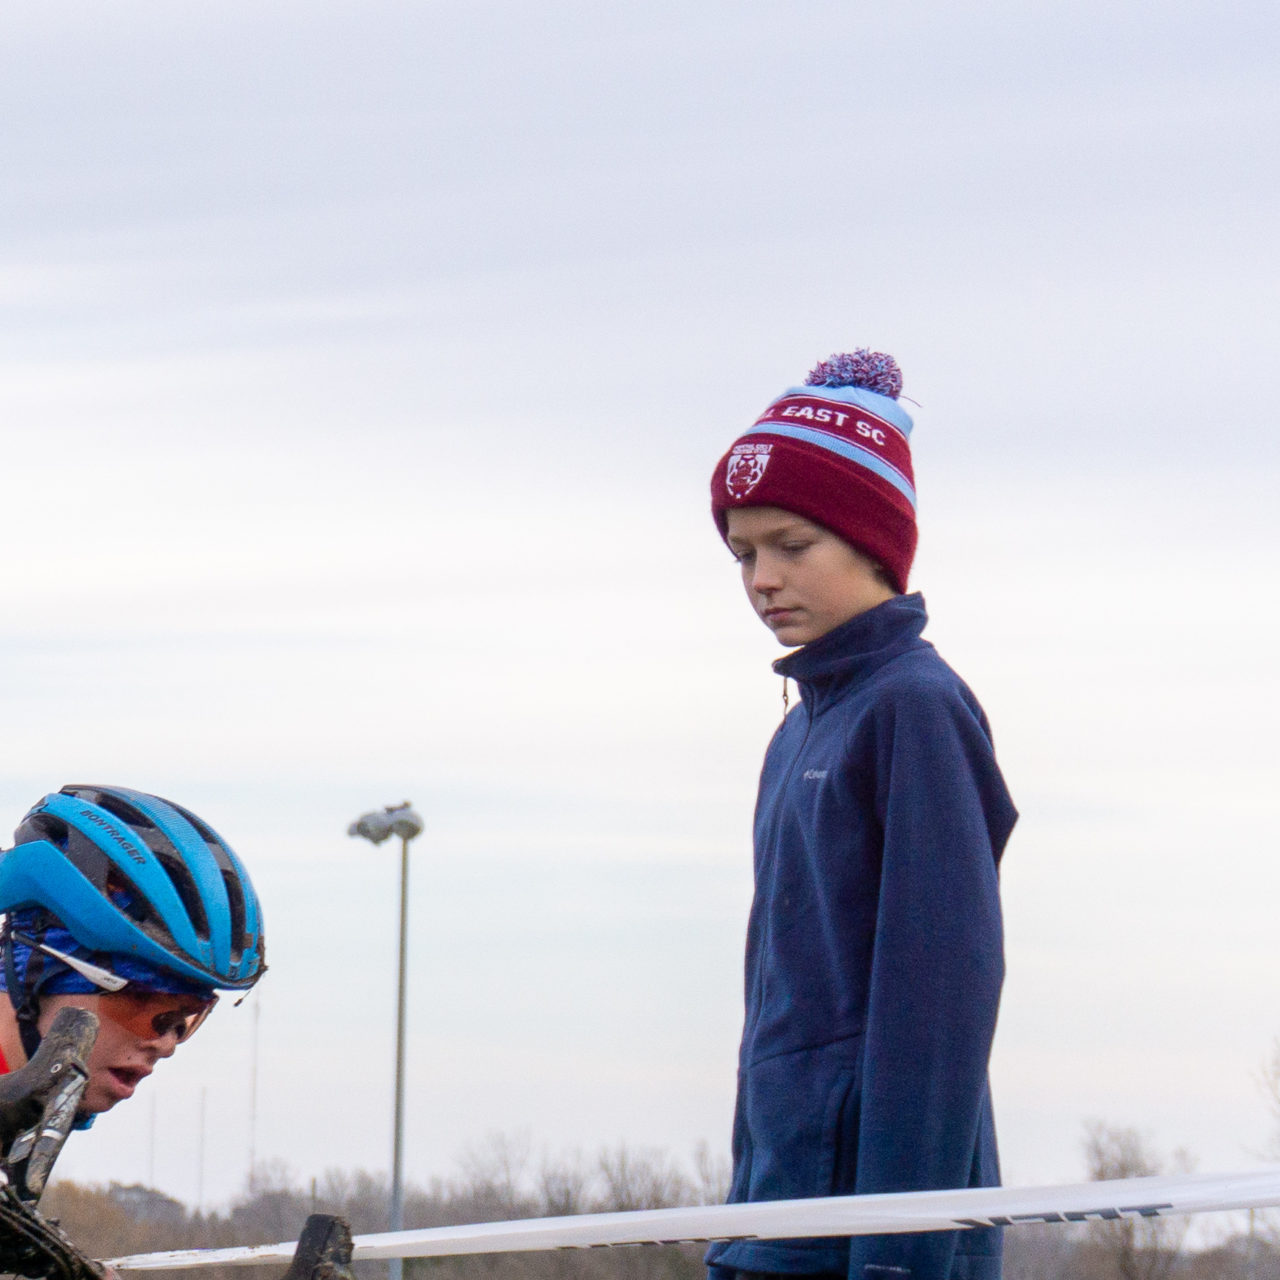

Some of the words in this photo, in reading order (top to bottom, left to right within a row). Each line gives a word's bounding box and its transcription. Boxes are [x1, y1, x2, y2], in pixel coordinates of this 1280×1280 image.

[781, 406, 850, 427] EAST
[855, 420, 887, 447] SC
[80, 809, 147, 865] BONTRAGER
